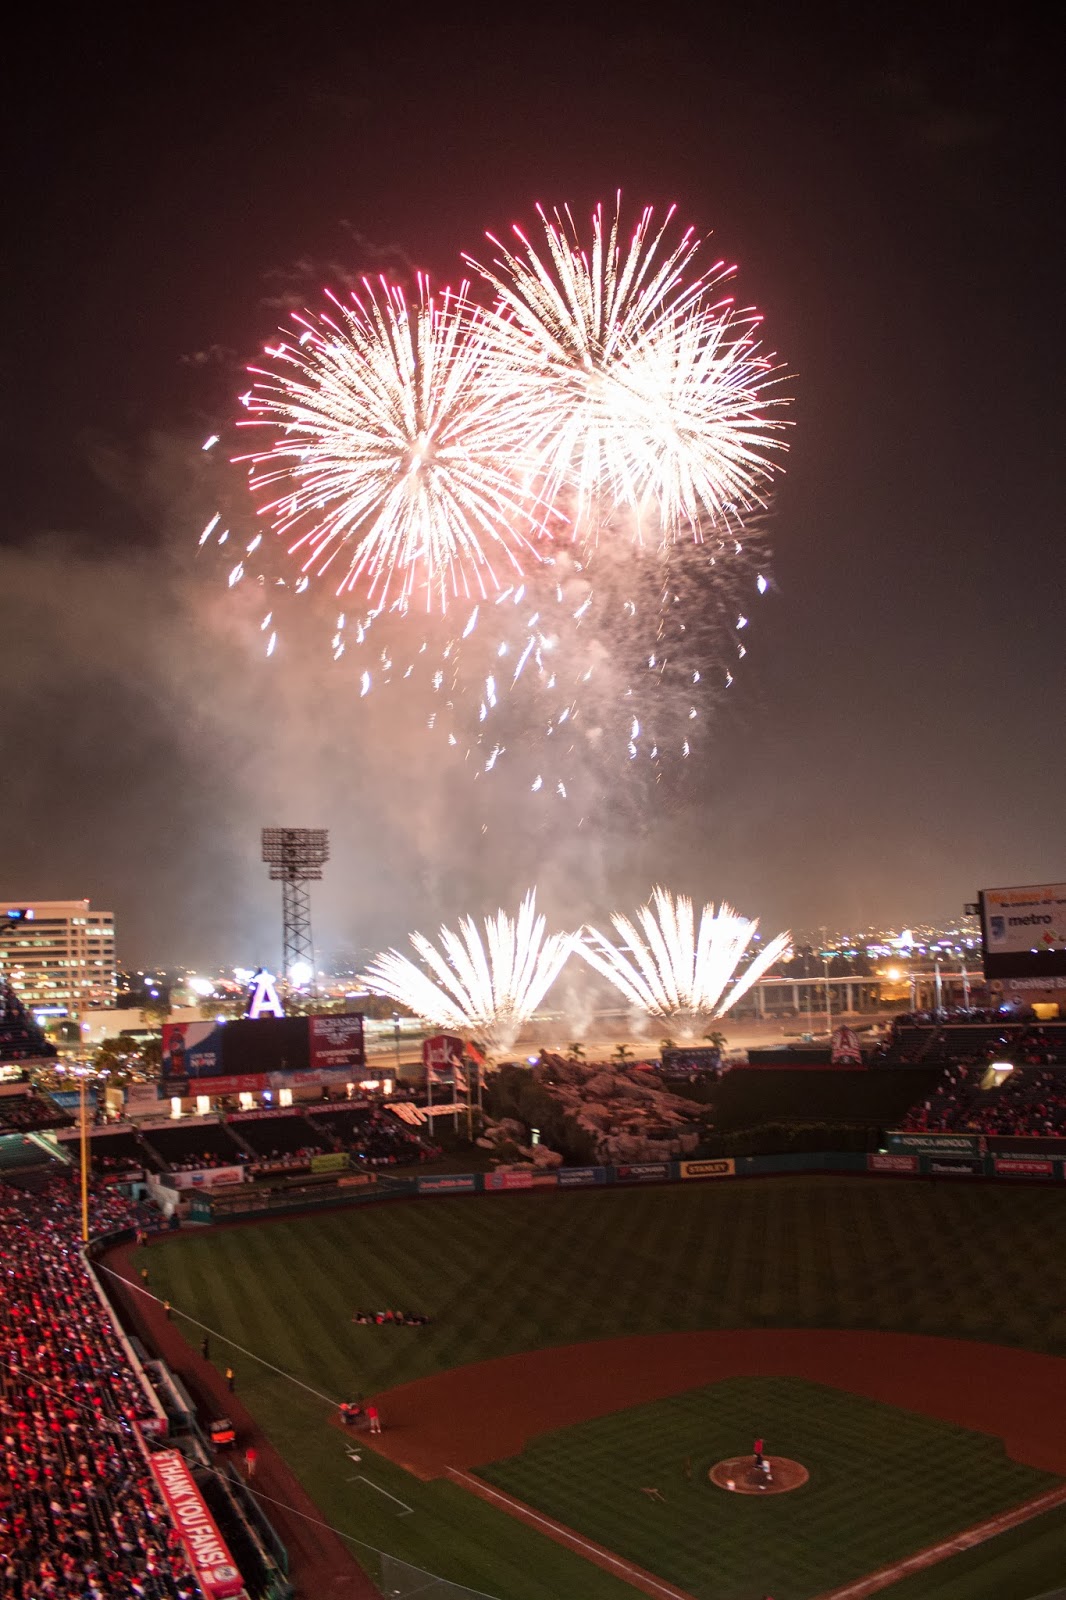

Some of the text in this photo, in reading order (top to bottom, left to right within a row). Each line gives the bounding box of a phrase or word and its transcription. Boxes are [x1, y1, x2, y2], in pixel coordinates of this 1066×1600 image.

[1008, 914, 1052, 926] metro
[250, 967, 285, 1019] A
[901, 1137, 933, 1147] KONICA
[687, 1165, 726, 1174] STANLEY
[157, 1458, 196, 1500] THANK
[174, 1497, 209, 1527] YOU
[185, 1525, 229, 1568] FANS!
